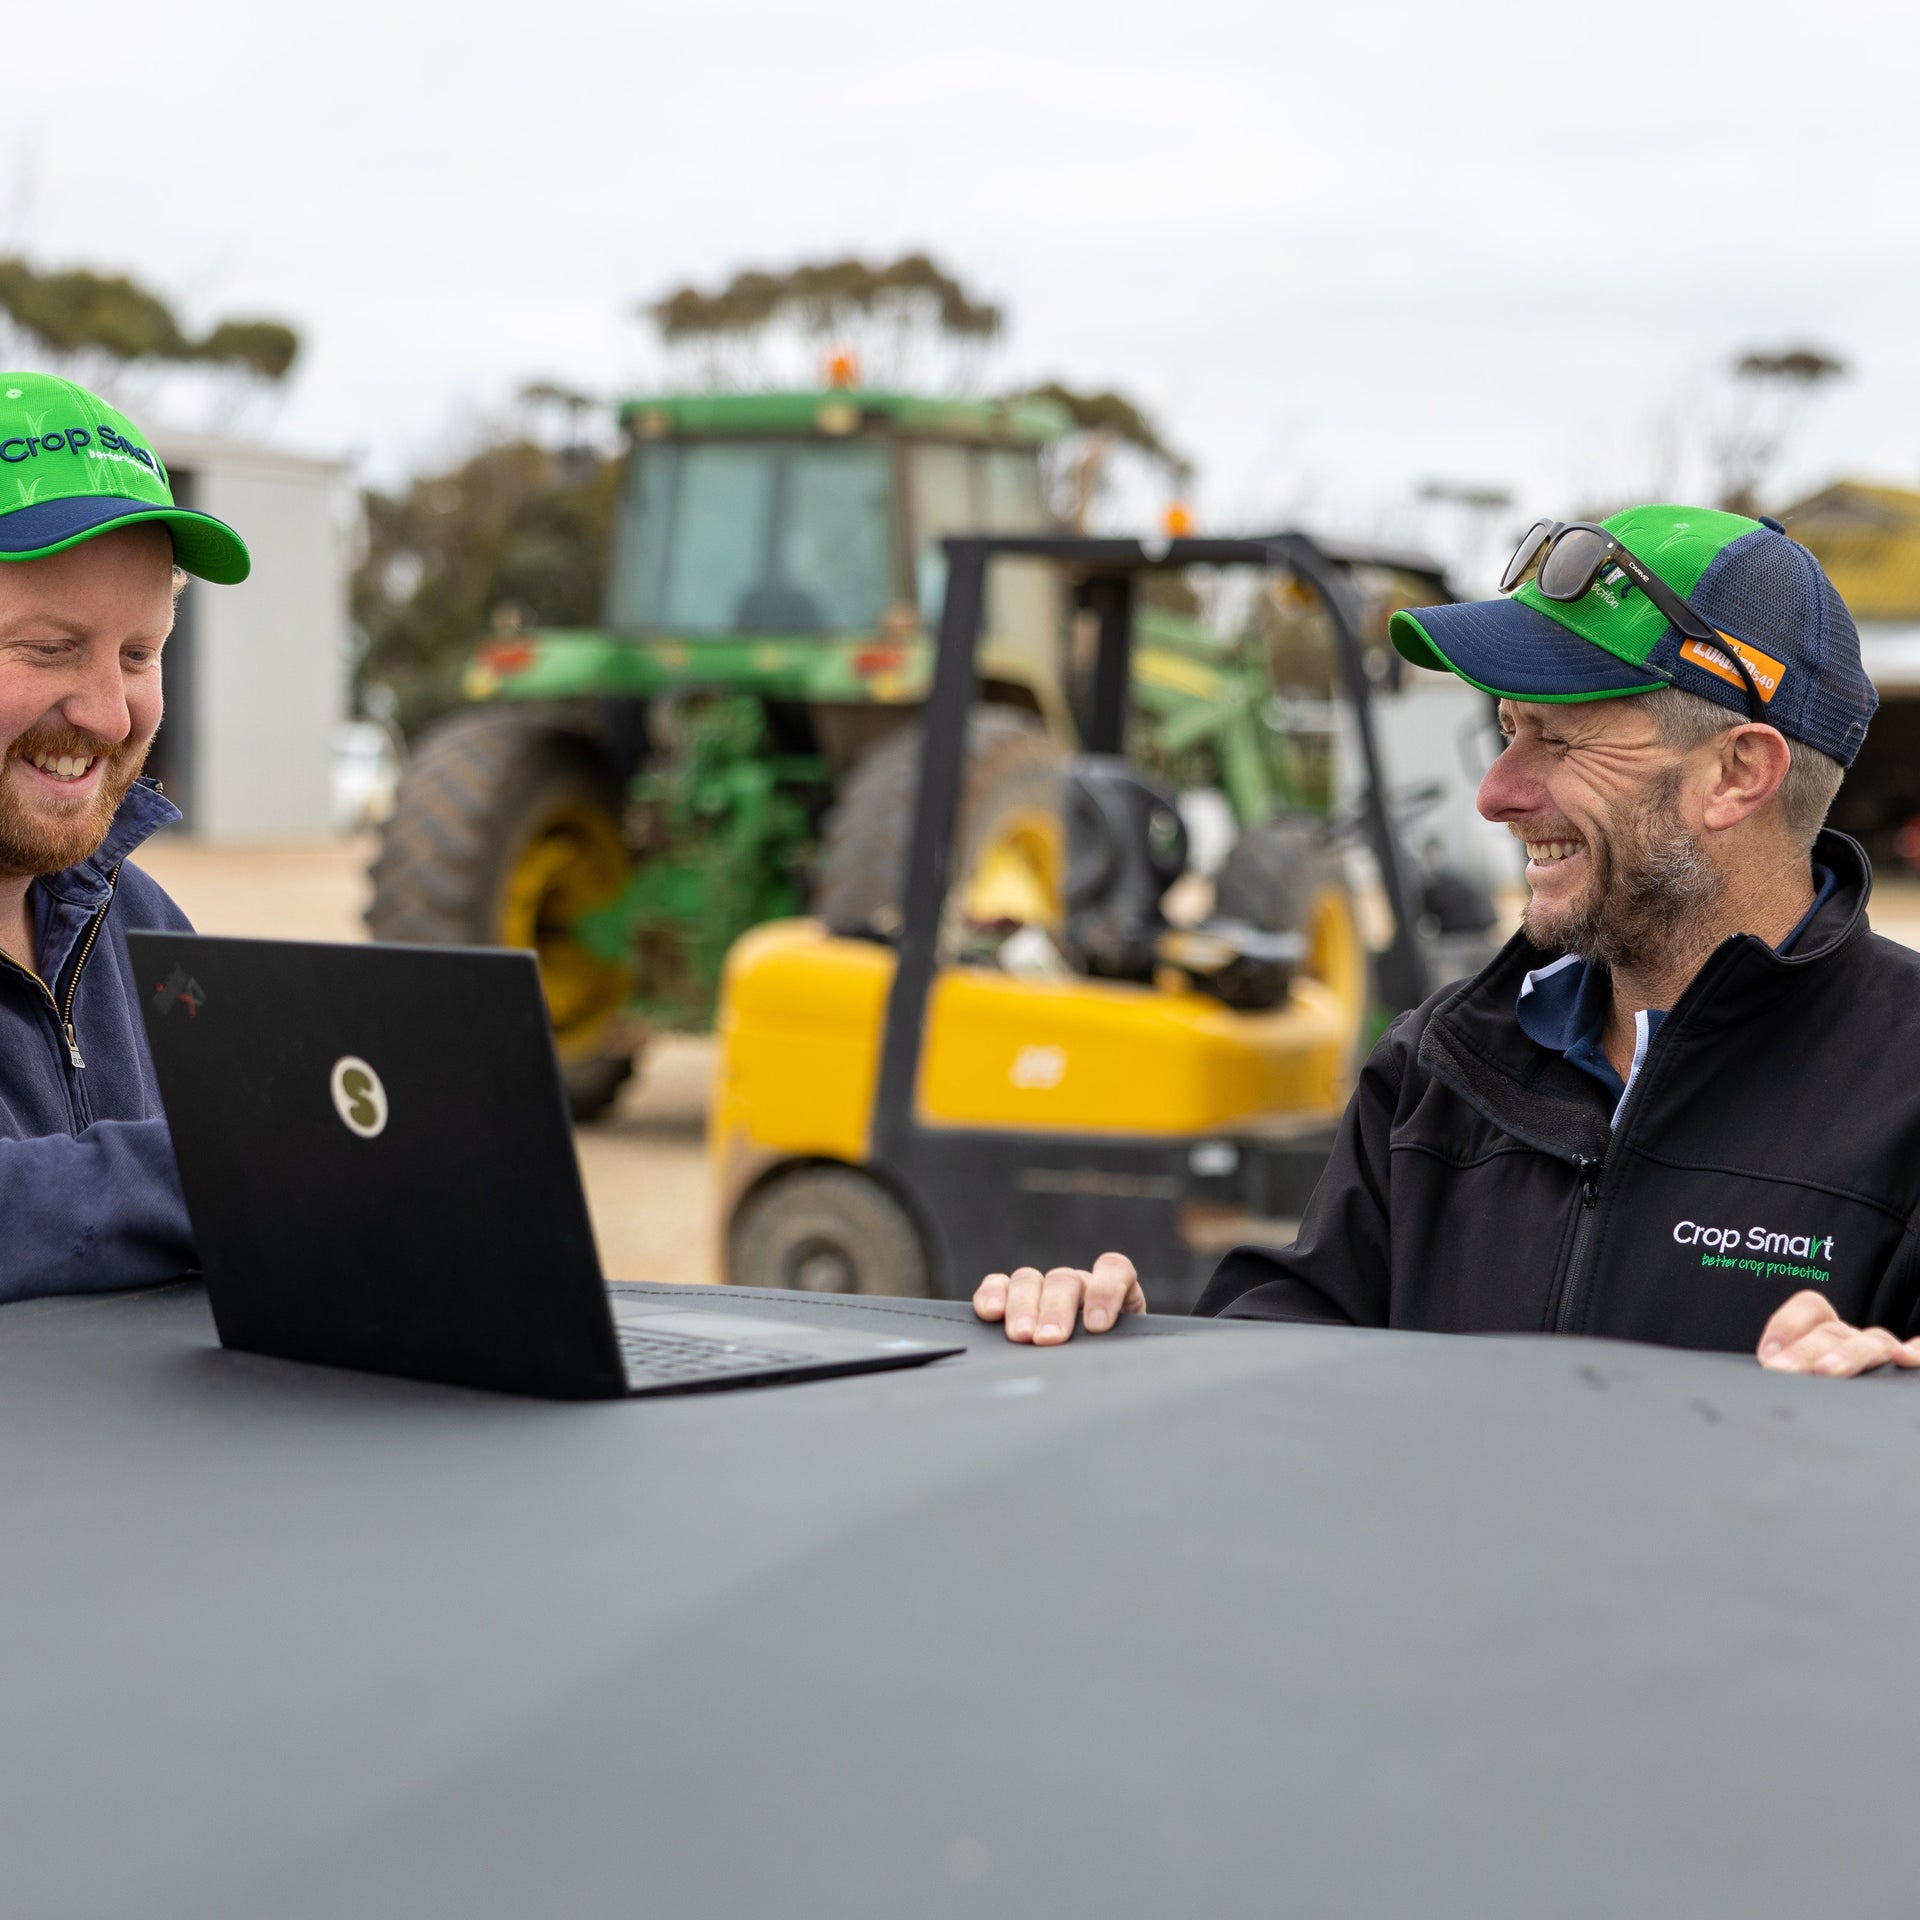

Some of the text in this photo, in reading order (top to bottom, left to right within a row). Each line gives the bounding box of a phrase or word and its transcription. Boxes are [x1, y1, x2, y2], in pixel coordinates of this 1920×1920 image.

[0, 427, 91, 463] Crop
[1673, 1220, 1835, 1261] Crop Smart
[1701, 1253, 1830, 1282] better crop protection
